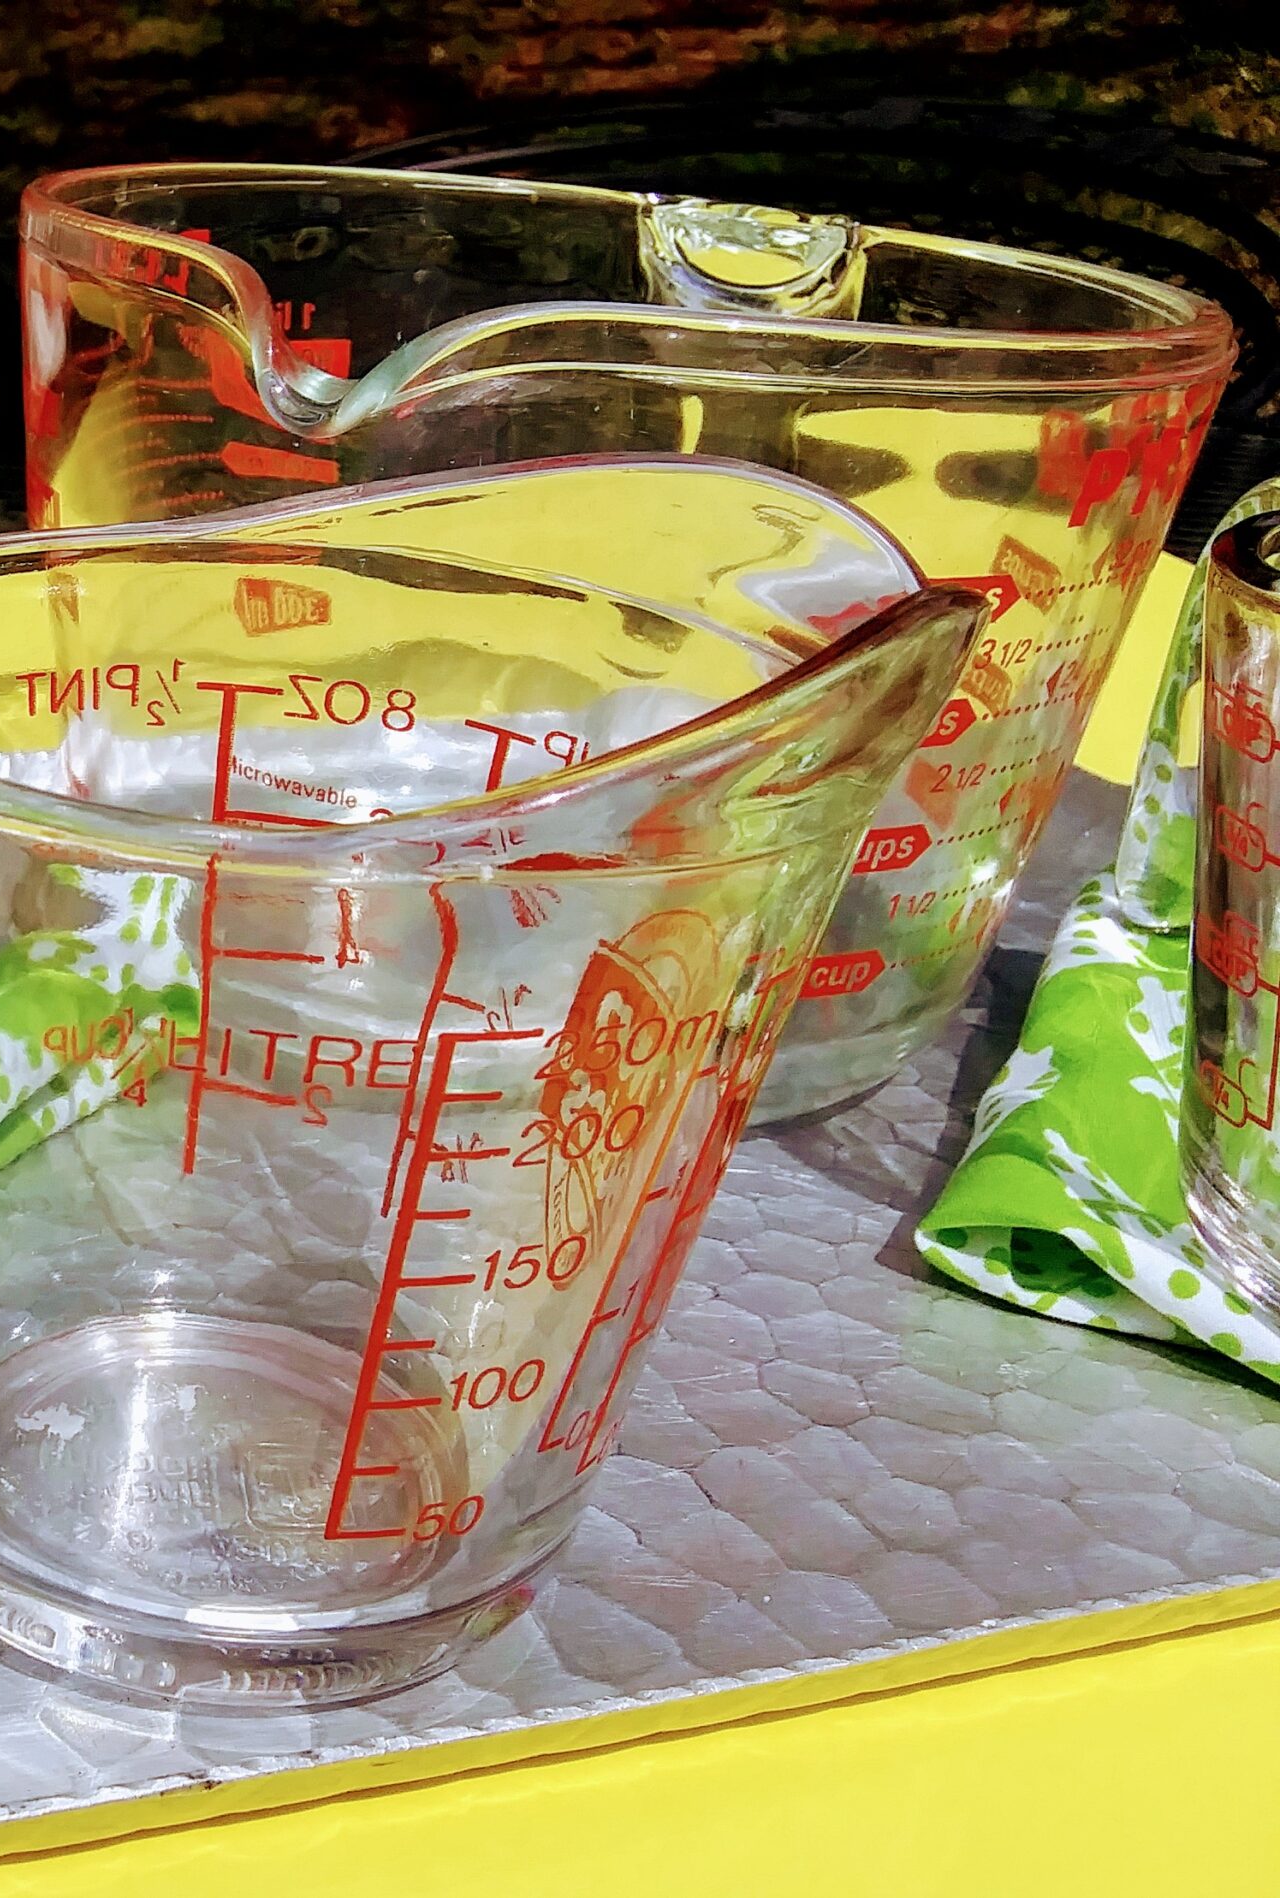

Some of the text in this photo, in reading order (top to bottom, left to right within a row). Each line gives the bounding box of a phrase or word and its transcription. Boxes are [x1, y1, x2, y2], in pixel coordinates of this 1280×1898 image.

[974, 638, 1033, 669] 3 1/2
[930, 762, 987, 793] 2 1/2
[859, 834, 915, 870] ups
[811, 959, 870, 989] cup
[169, 1018, 421, 1090] LITRE
[513, 1104, 645, 1167] 200
[483, 1235, 587, 1292] 150
[450, 1359, 545, 1411] 100
[412, 1495, 485, 1542] 50
